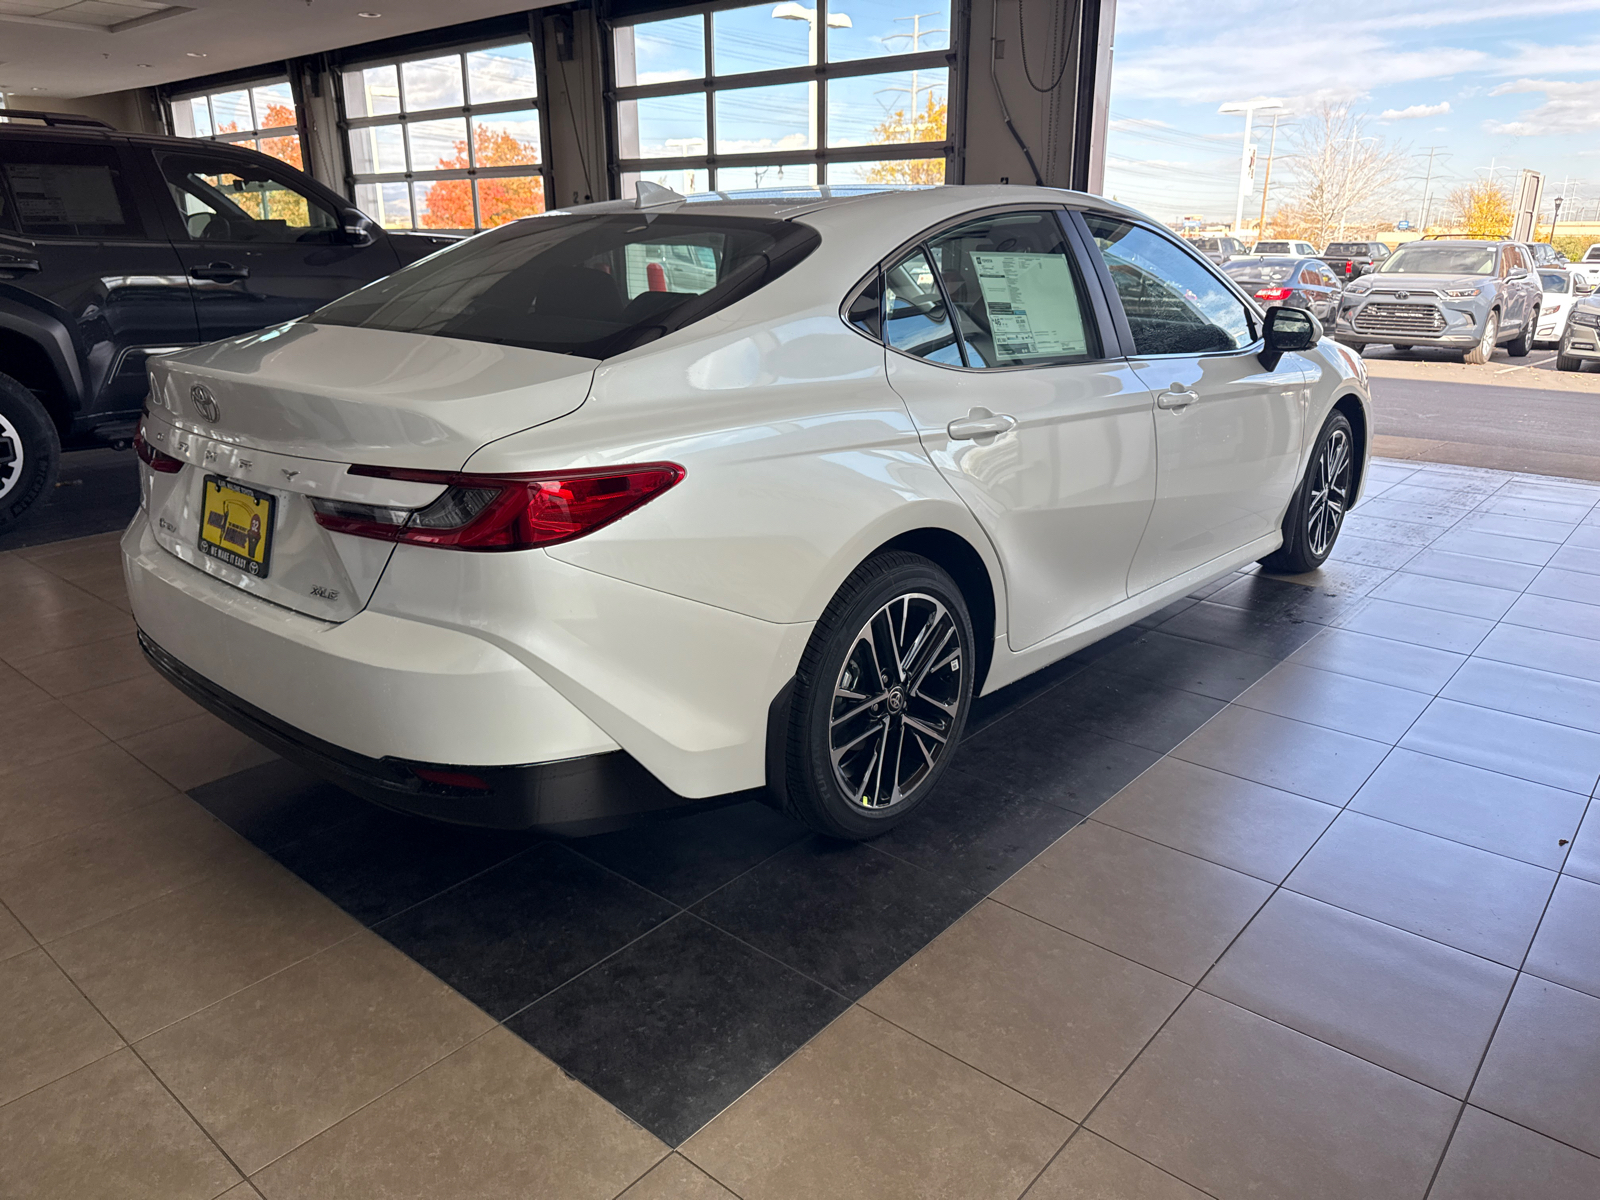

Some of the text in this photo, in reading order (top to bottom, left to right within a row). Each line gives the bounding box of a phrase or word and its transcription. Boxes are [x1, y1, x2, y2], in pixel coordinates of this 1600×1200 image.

[210, 545, 217, 556] WE
[217, 548, 230, 562] MAKE
[234, 555, 247, 569] EASY
